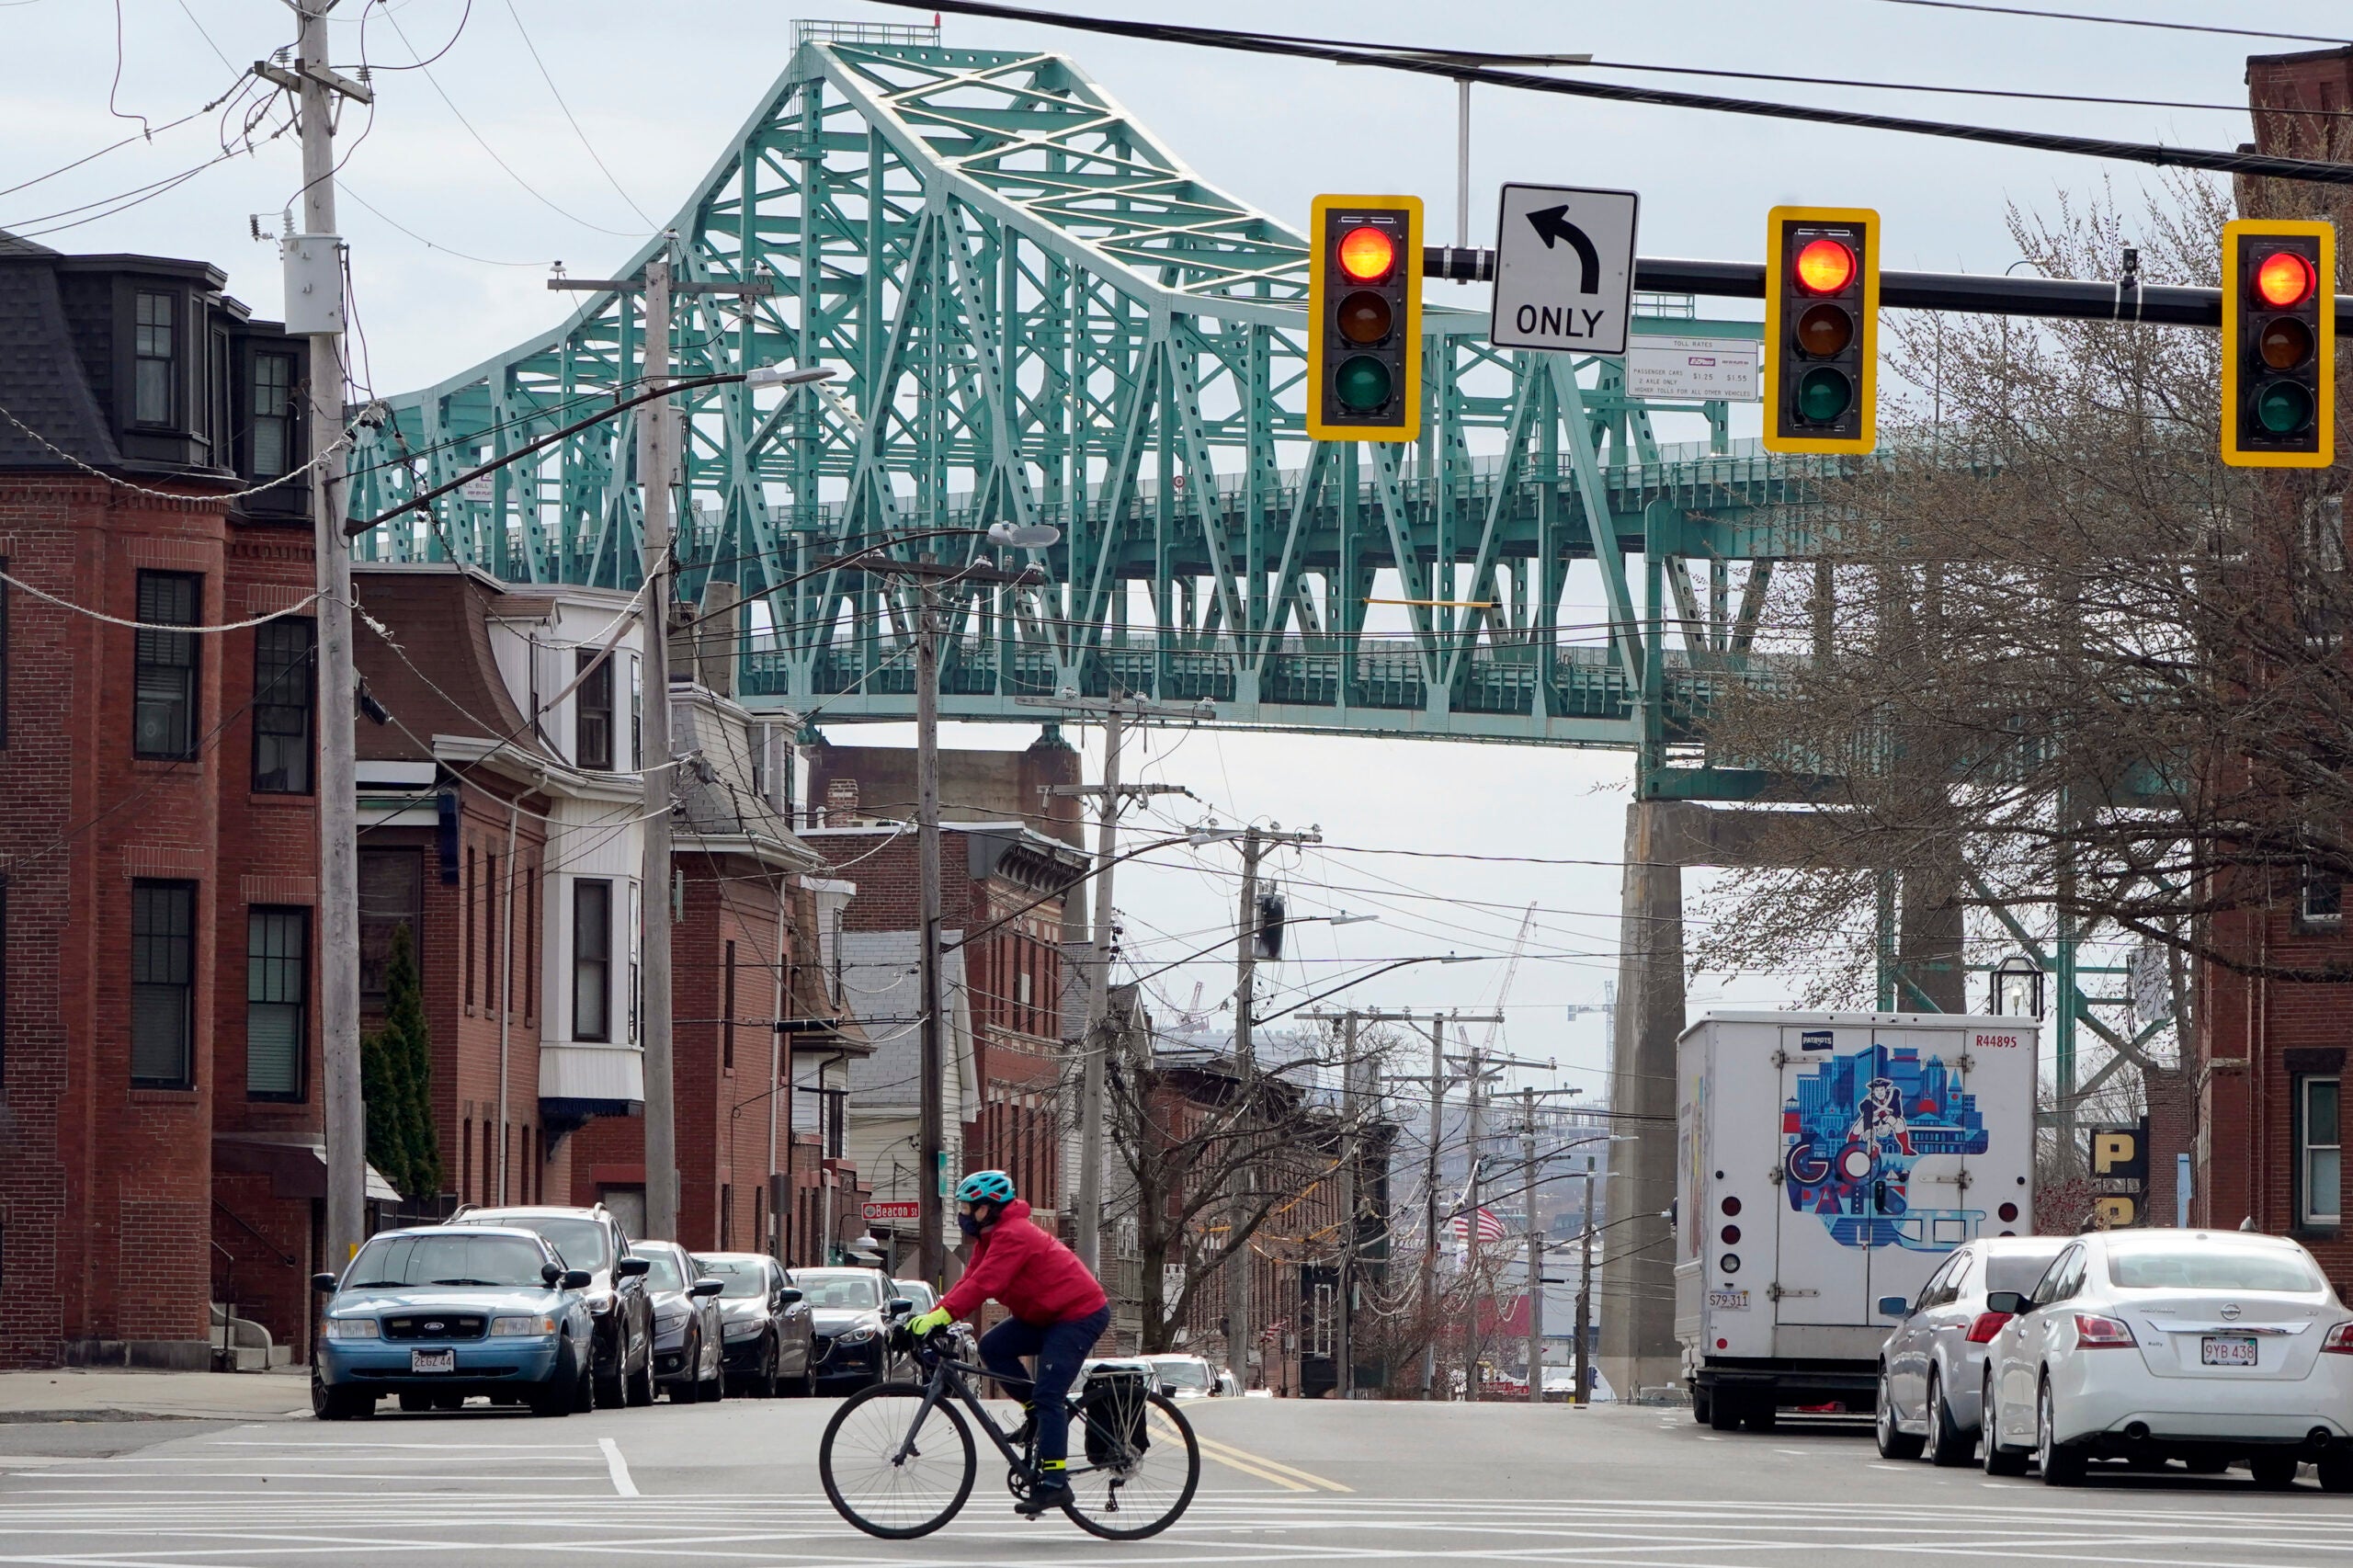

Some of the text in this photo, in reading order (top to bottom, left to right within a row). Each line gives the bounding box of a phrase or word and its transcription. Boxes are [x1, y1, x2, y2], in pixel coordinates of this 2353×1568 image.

[1517, 304, 1604, 338] ONLY
[1802, 1036, 1832, 1046] PATRIOTS
[1976, 1035, 2017, 1048] R44895
[1786, 1140, 1881, 1187] GO
[1788, 1180, 1907, 1215] PATS
[876, 1204, 918, 1217] Beacon St
[2205, 1345, 2255, 1359] 9YB 438
